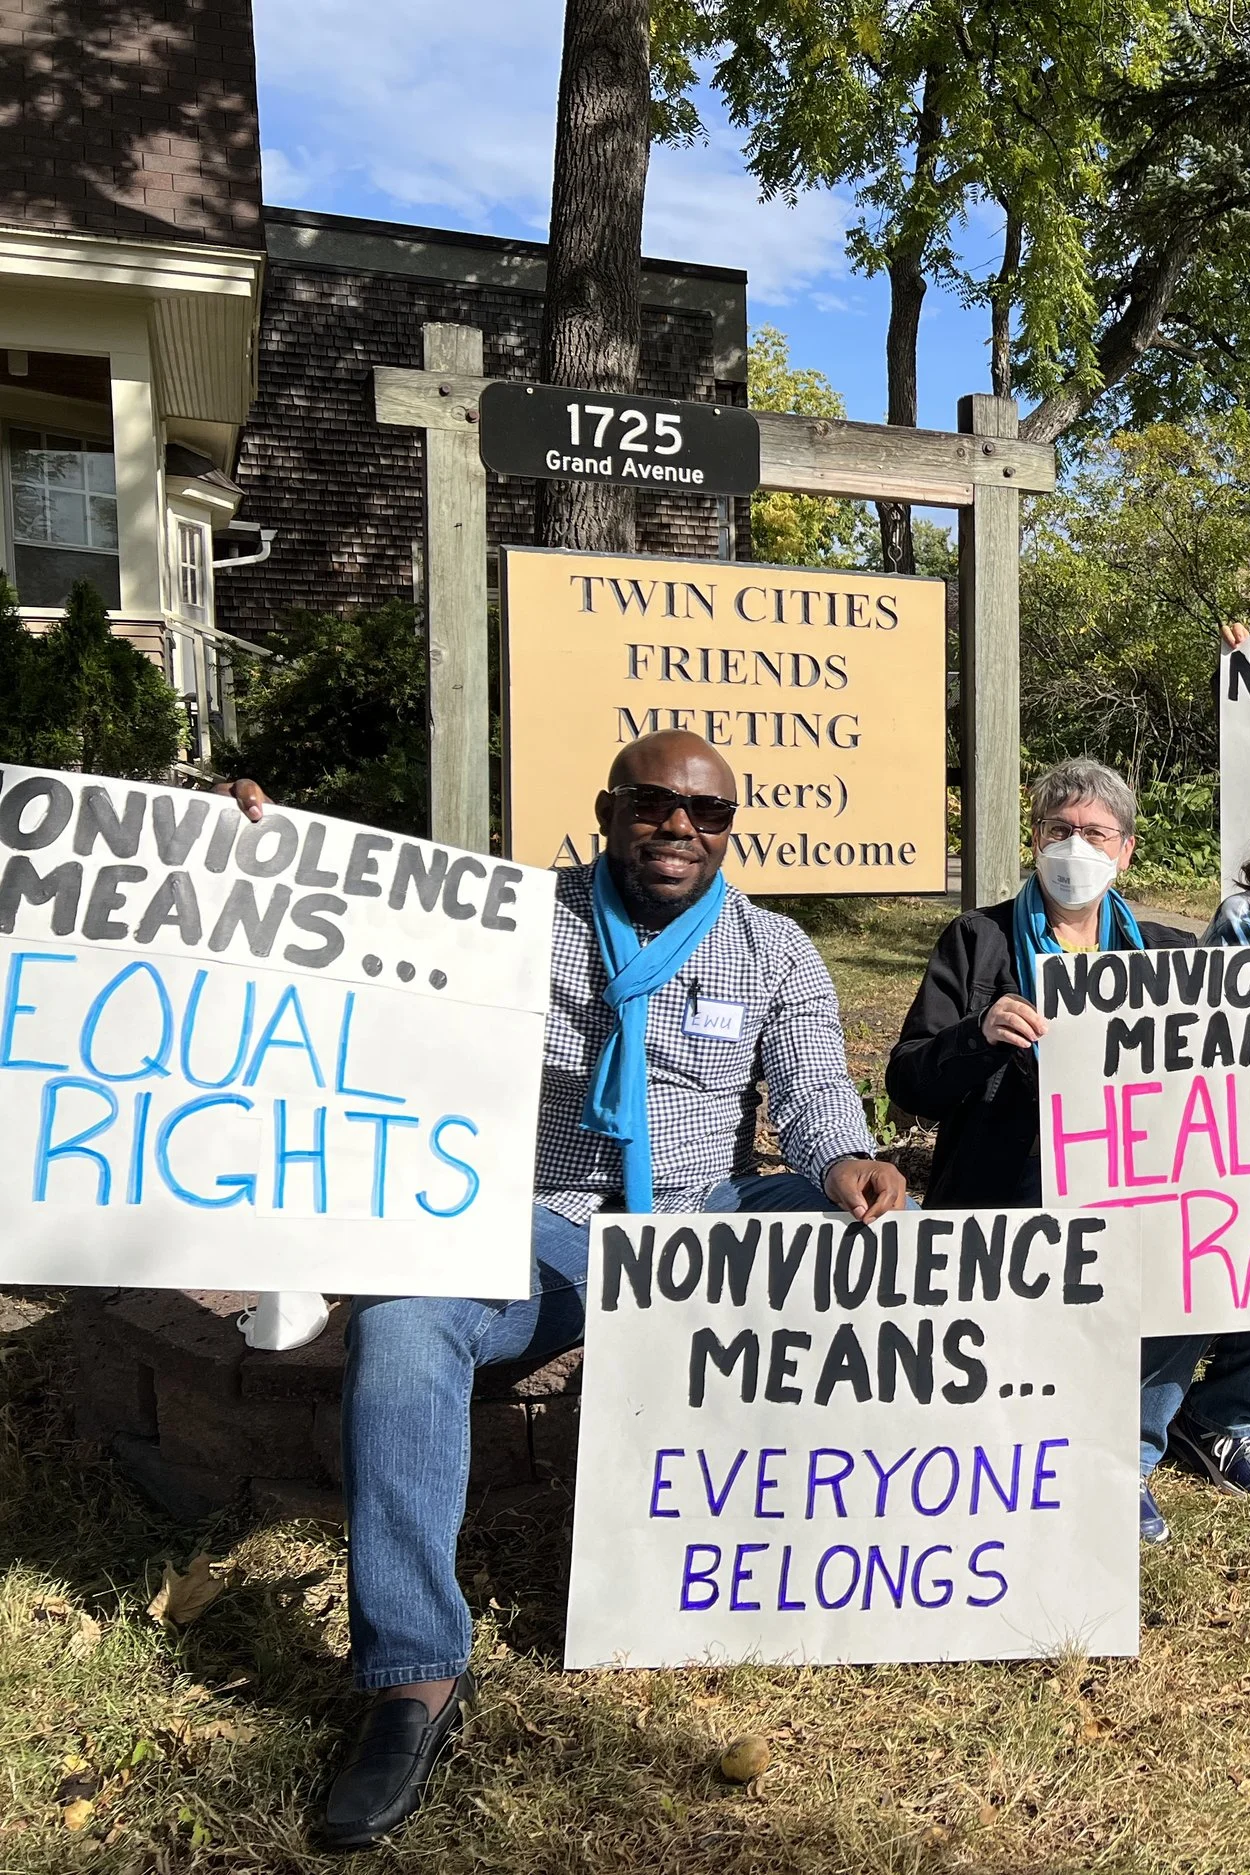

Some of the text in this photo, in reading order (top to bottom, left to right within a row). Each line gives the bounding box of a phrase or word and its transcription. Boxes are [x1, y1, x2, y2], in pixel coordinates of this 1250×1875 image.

[566, 402, 683, 456] 1725
[545, 451, 705, 484] Grand Avenue
[569, 573, 900, 631] TWIN CITIES
[624, 643, 849, 690] FRIENDS
[613, 706, 862, 749] MEETING
[0, 769, 523, 931] ONVIOLENCE
[731, 833, 917, 868] Welcome
[0, 855, 448, 990] MEANS...
[0, 952, 406, 1104] EQUAL
[33, 1076, 479, 1218] RIGHTS
[602, 1214, 1106, 1311] NONVIOLENCE
[689, 1319, 1056, 1408] MEANS...
[649, 1438, 1069, 1519] EVERYONE
[679, 1541, 1008, 1611] BELONGS
